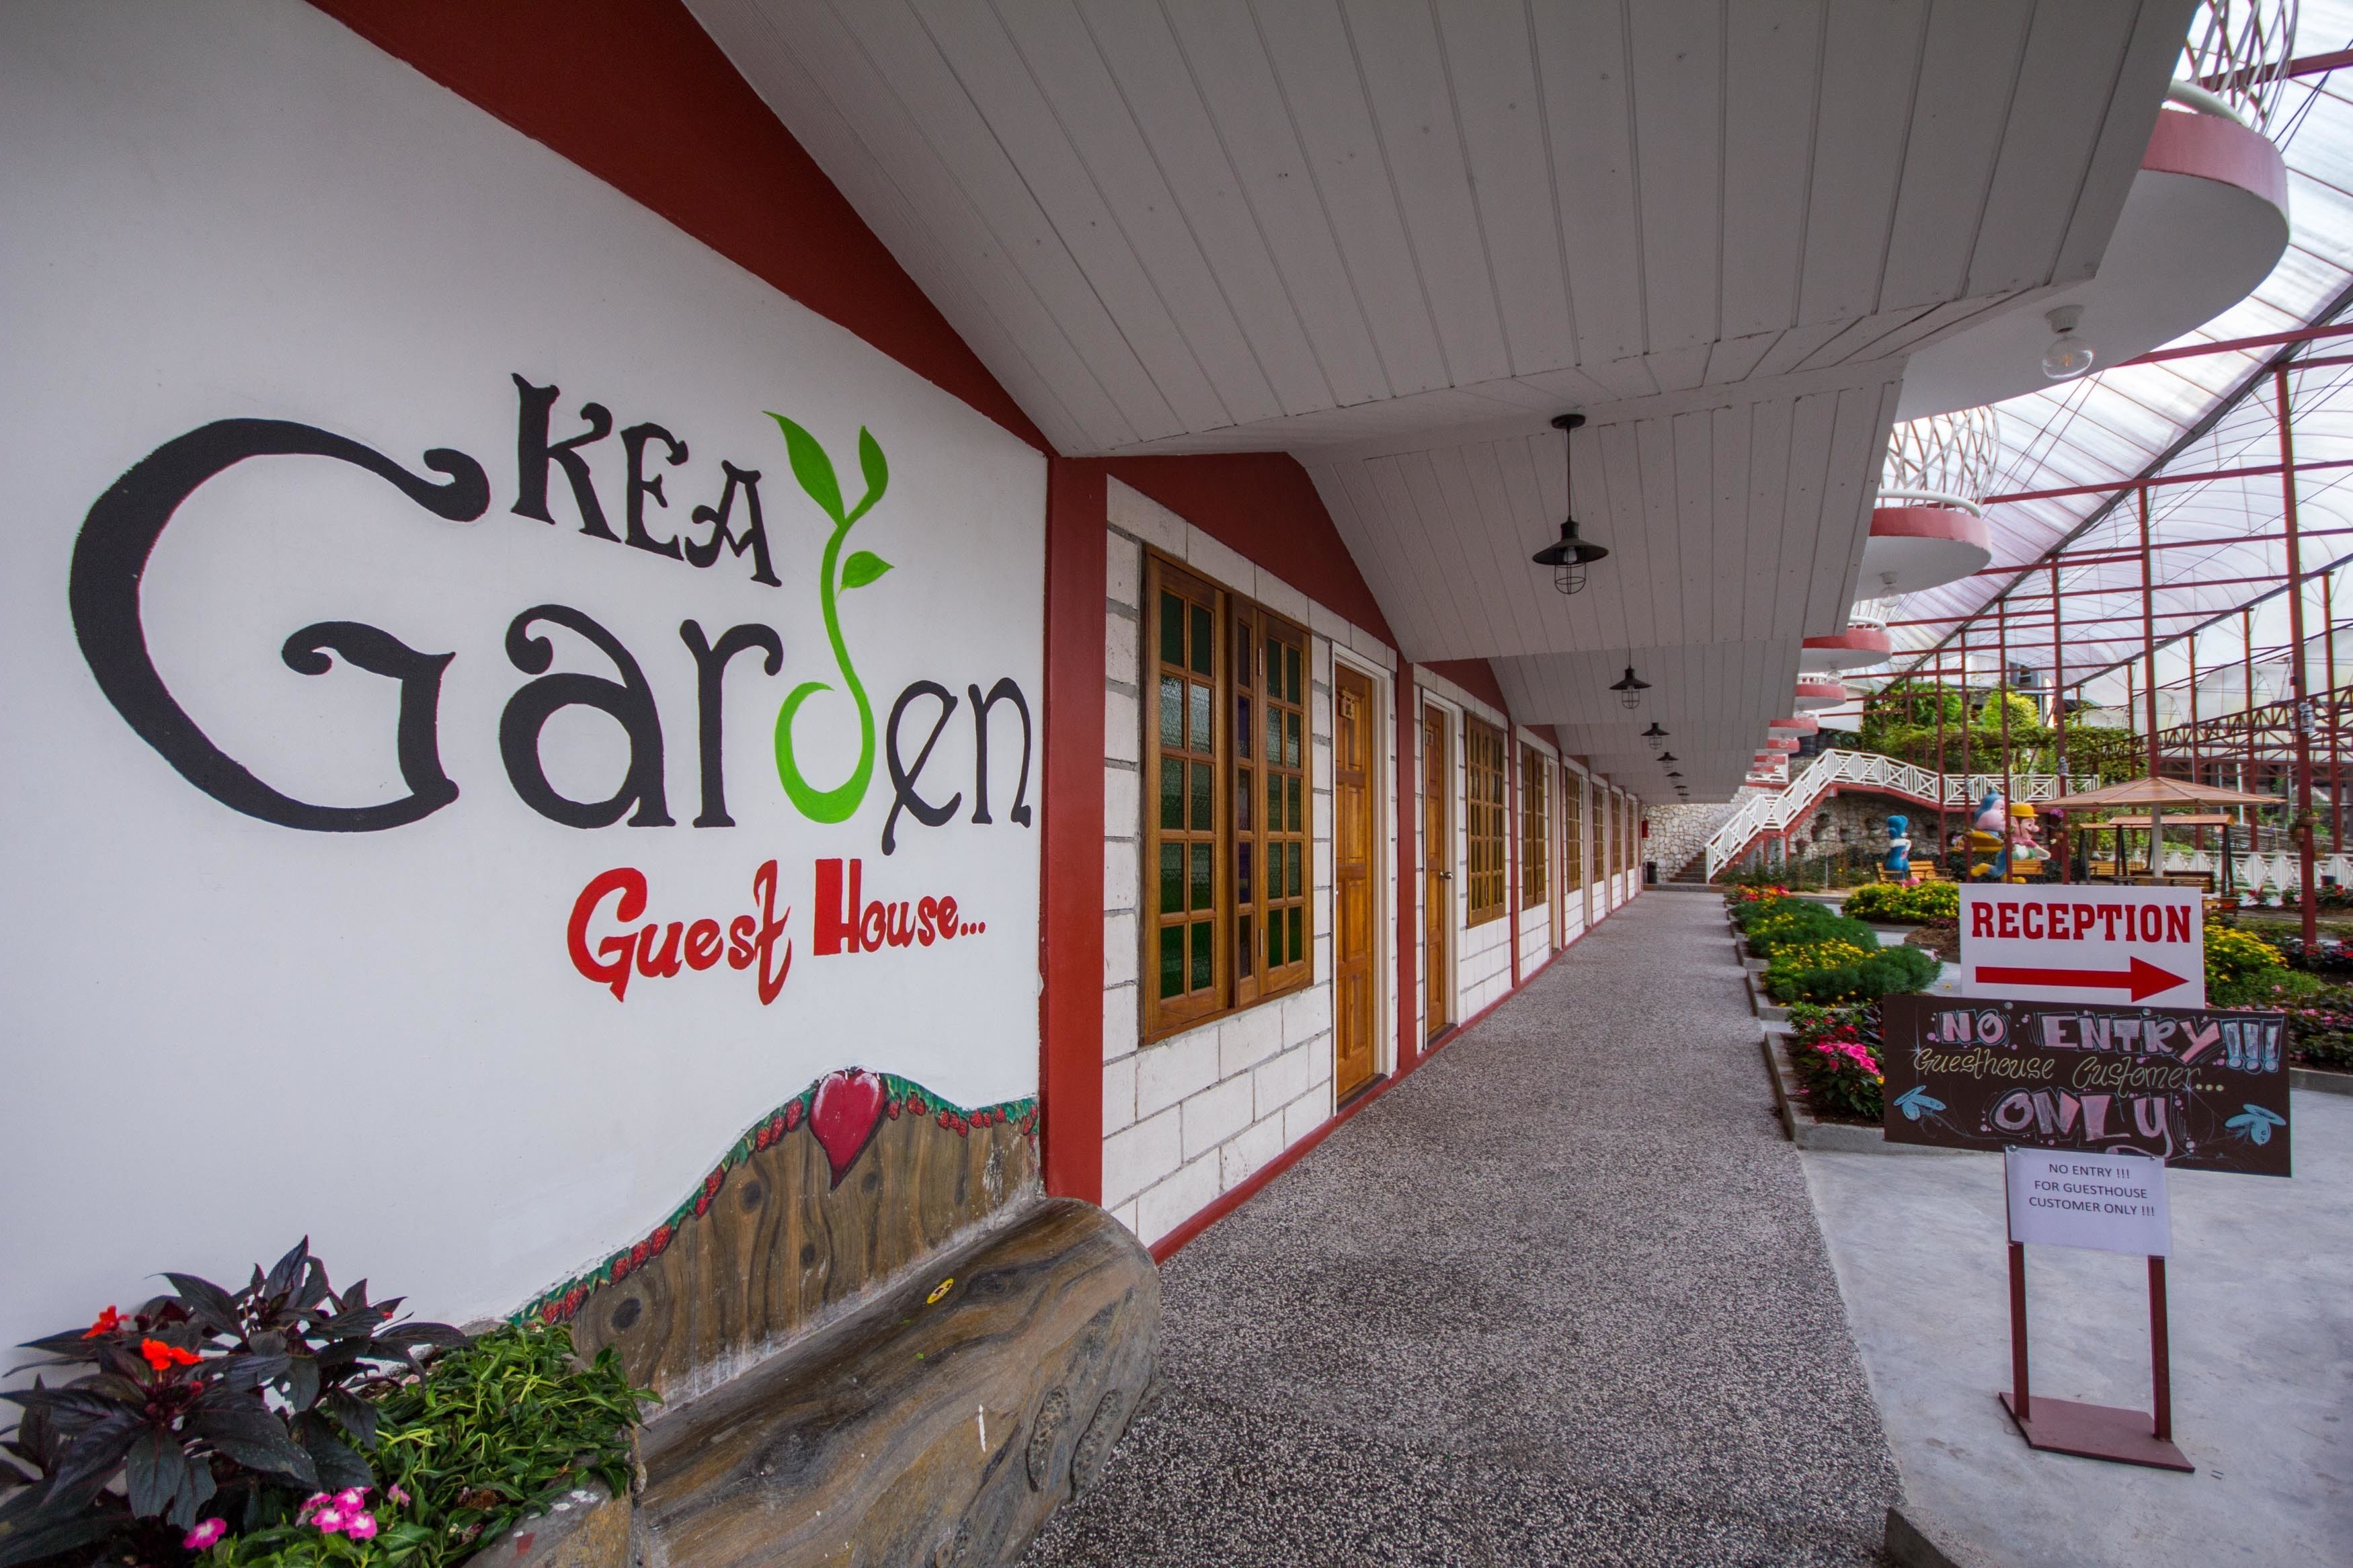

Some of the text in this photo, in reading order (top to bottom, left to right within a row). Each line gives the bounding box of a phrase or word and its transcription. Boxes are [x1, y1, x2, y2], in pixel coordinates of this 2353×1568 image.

[69, 411, 1031, 856] Garden
[567, 858, 986, 1005] Guest House...
[1971, 901, 2191, 943] RECEPTION
[1940, 1009, 2007, 1045] NO
[1913, 1047, 2055, 1079] Guesthouse
[1993, 1089, 2173, 1157] ONLY
[2049, 1163, 2130, 1179] NO ENTRY !!!
[2028, 1196, 2155, 1216] CUSTOMER ONLY !!!
[2034, 1180, 2148, 1199] FOR GUESTHOUSE
